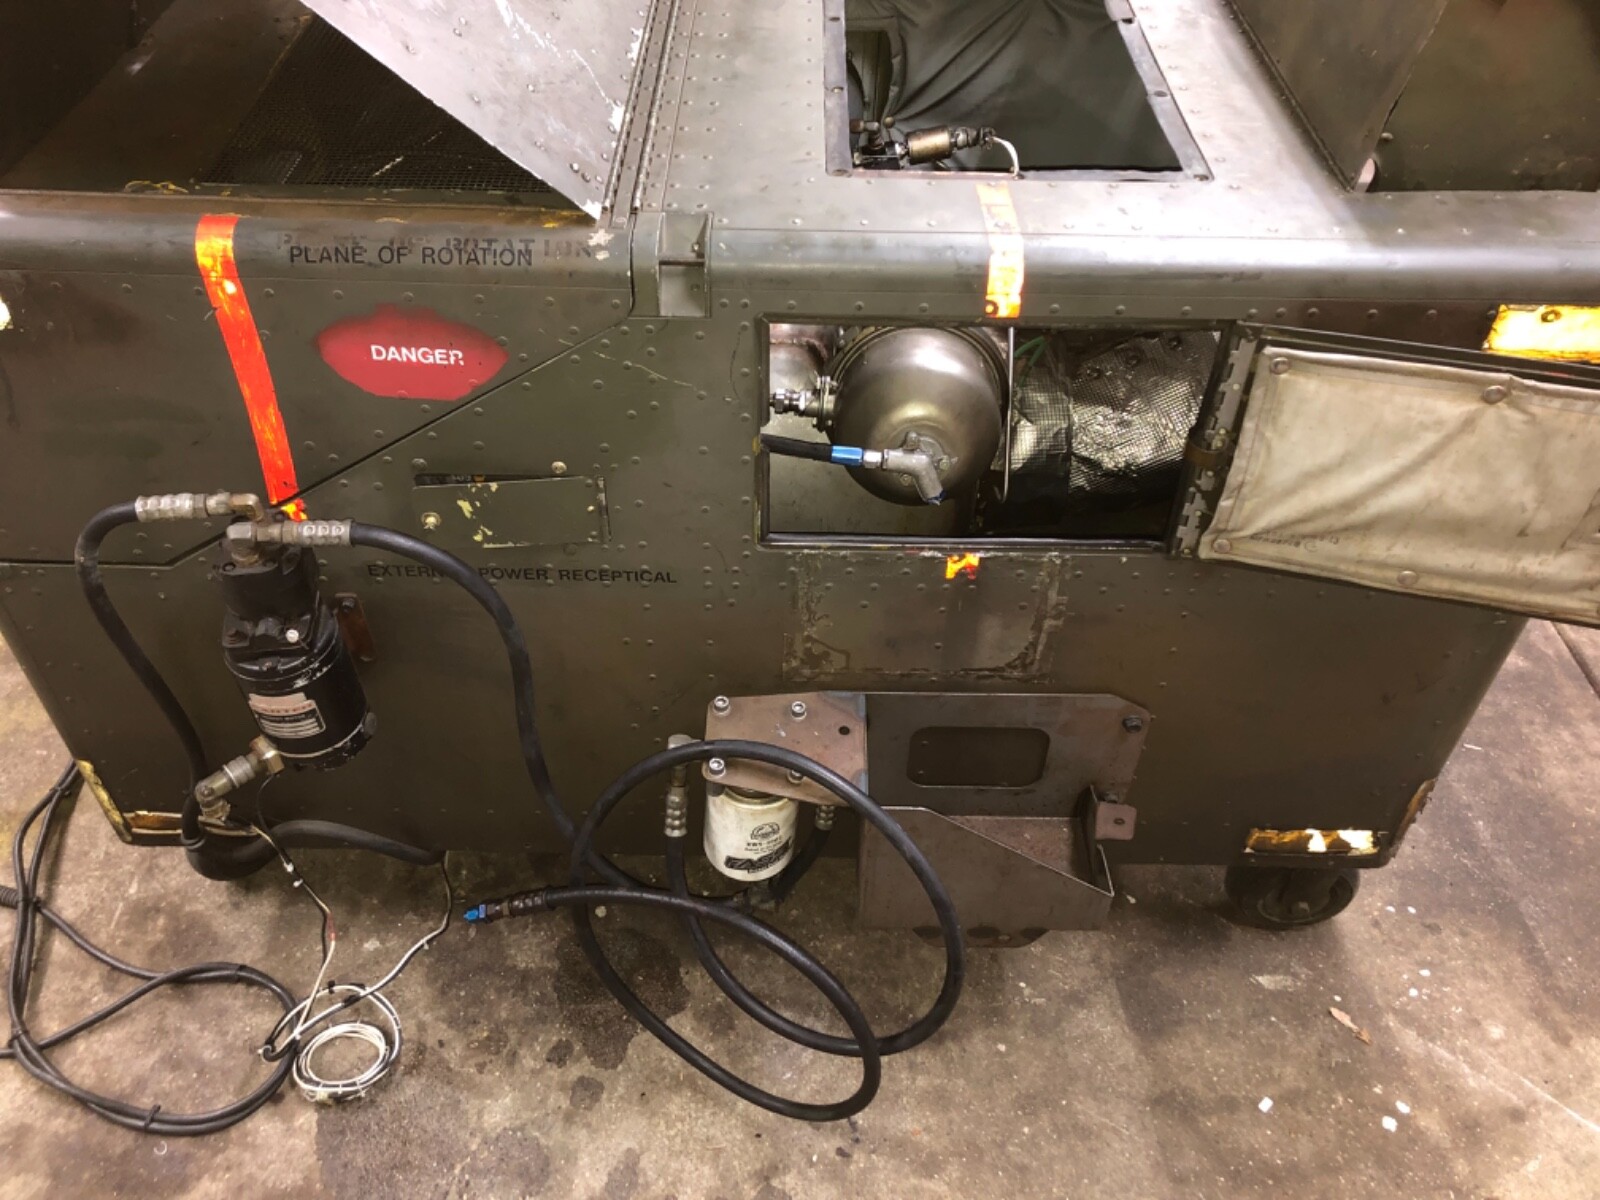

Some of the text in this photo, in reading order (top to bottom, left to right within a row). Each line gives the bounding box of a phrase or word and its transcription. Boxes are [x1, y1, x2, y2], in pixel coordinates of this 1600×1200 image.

[289, 246, 533, 266] PLANE OF ROTATION
[370, 344, 464, 366] DANGER
[367, 564, 678, 584] EXTERN POWER RECEPTICAL
